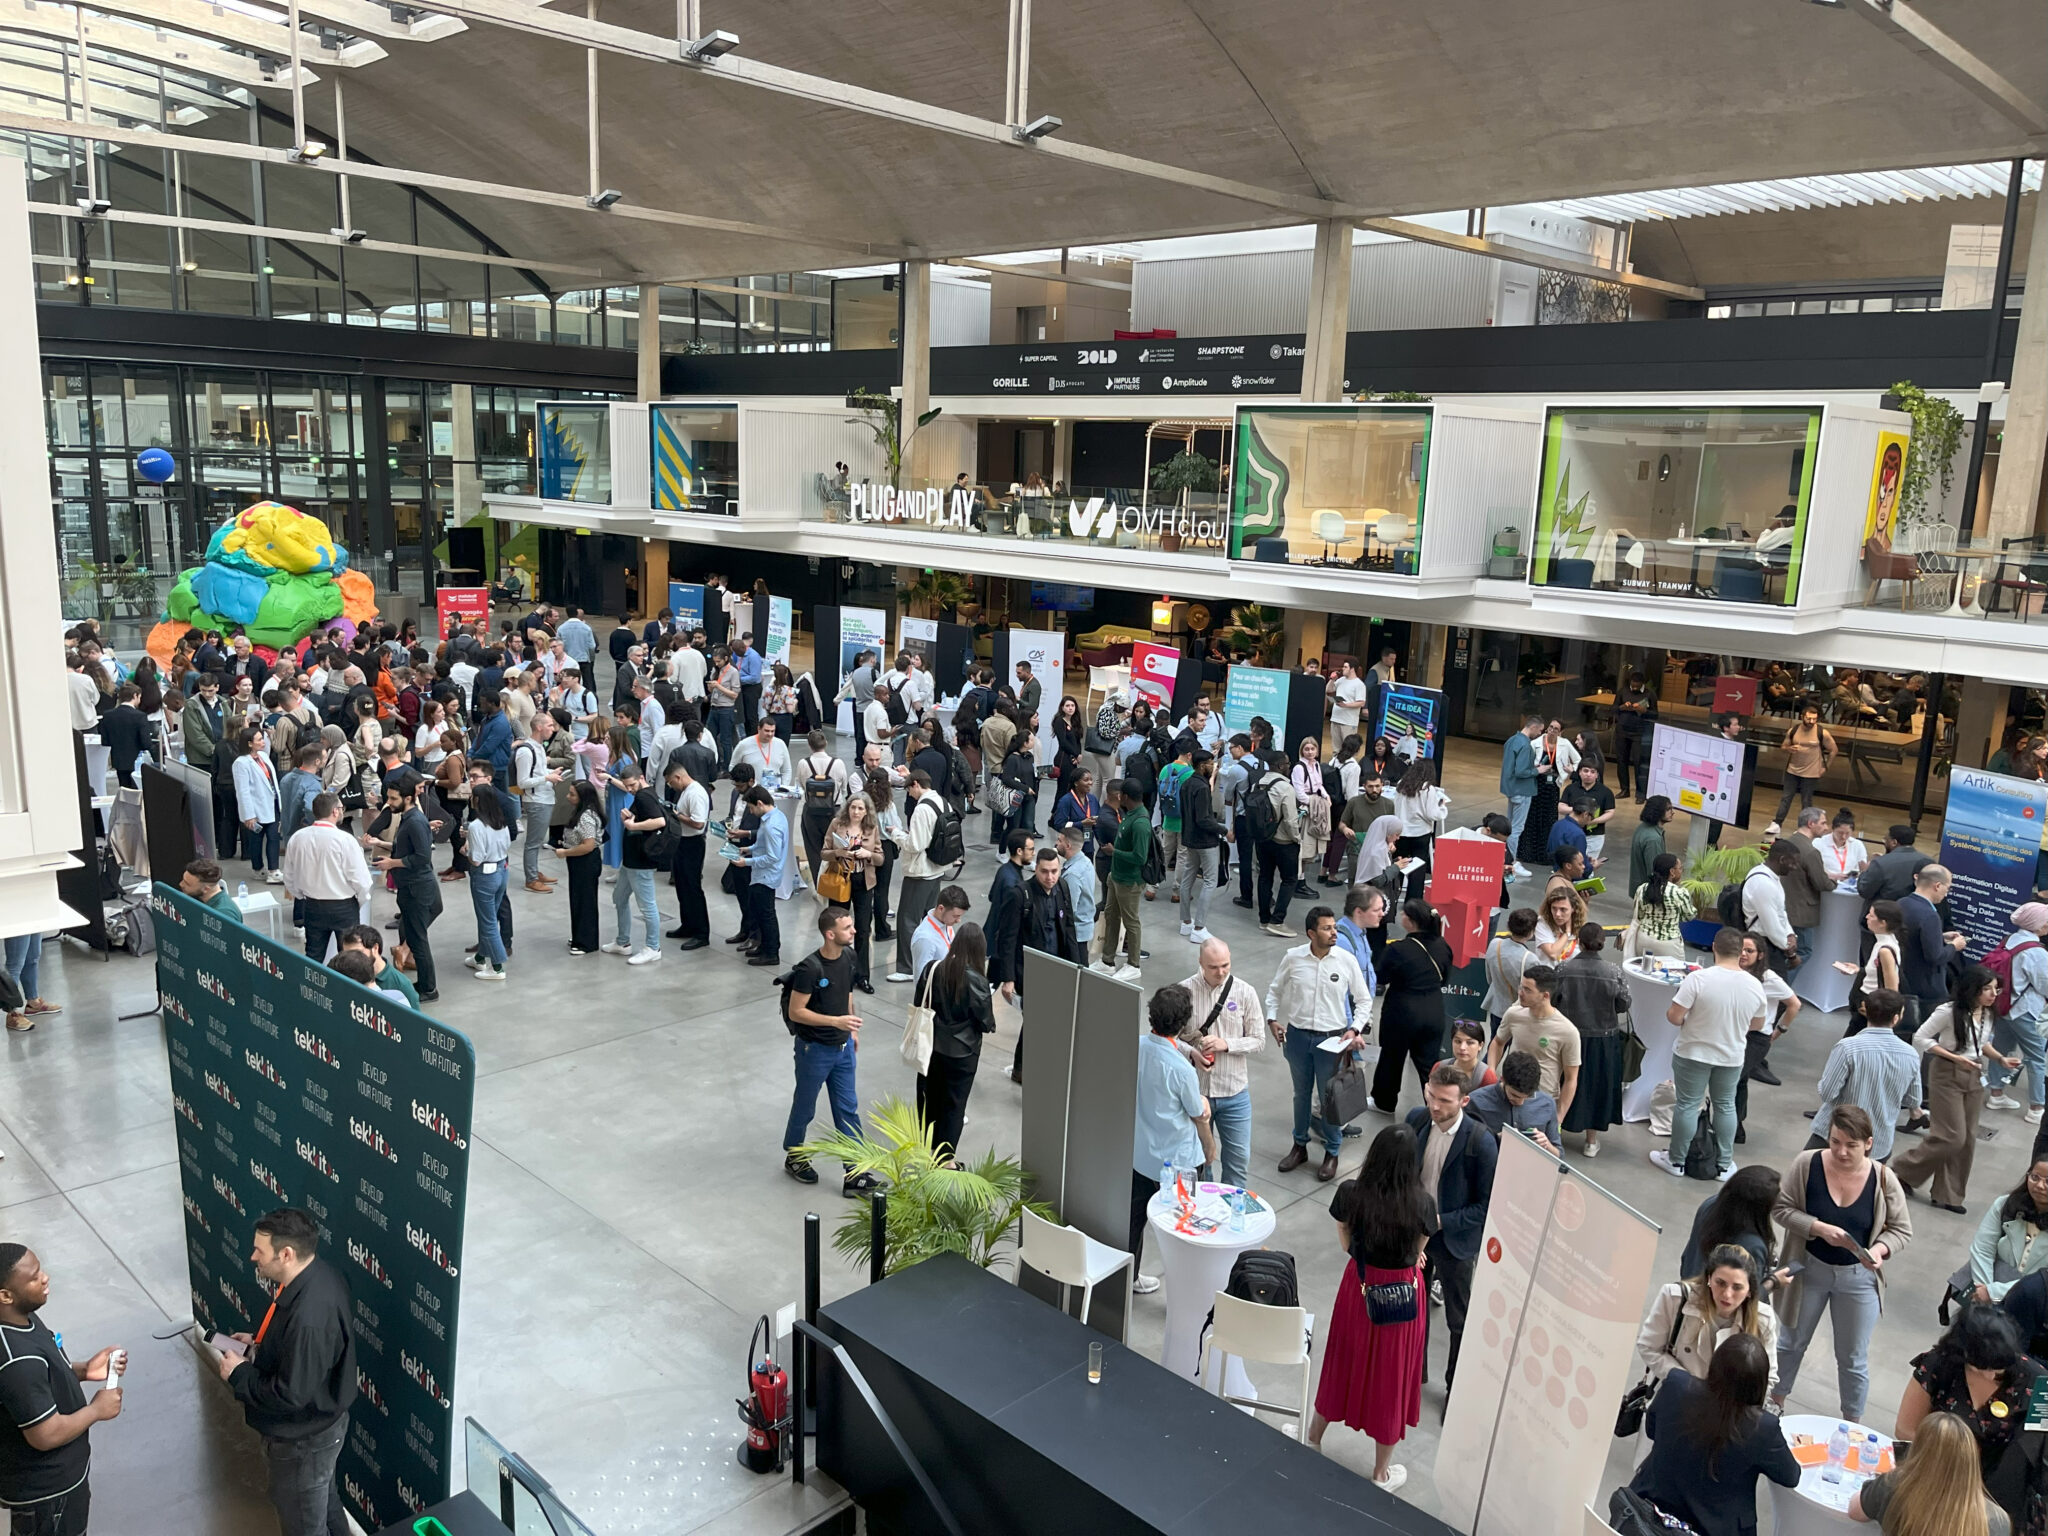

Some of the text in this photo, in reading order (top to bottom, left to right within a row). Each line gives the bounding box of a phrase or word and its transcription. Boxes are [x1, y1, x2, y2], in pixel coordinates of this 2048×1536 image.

[1078, 350, 1117, 364] BOLD
[1197, 346, 1244, 355] SHARPSTONE
[1173, 378, 1208, 388] Amplitude
[841, 565, 855, 580] UP
[1622, 579, 1650, 587] SUBWAY
[1657, 581, 1692, 591] TRAMWAY
[1233, 672, 1243, 681] Pour
[1395, 702, 1422, 714] IT & IDEA
[1963, 774, 2033, 801] Artik Consulting
[1945, 830, 2034, 857] Conseil en architecture des
[1949, 839, 1982, 853] Systèmes
[1447, 873, 1494, 883] TABLE RONDE
[1458, 866, 1485, 875] ESPACE
[1994, 882, 2018, 895] Digitale
[1967, 904, 1978, 914] Big
[1978, 907, 1995, 917] Data
[304, 966, 328, 989] DEVELOP
[300, 984, 333, 1014] YOUR FUTURE
[428, 1027, 456, 1052] DEVELOP
[362, 1061, 388, 1086] DEVELOP
[421, 1047, 462, 1081] YOUR FUTURE
[306, 1078, 329, 1103] DEVELOP
[357, 1078, 393, 1112] YOUR FUTURE
[422, 1151, 449, 1180] DEVELOP
[360, 1177, 384, 1205] DEVELOP
[416, 1169, 453, 1209] YOUR FUTURE
[355, 1194, 389, 1232] YOUR FUTURE
[416, 1282, 440, 1312] DEVELOP
[410, 1299, 445, 1341] YOUR FUTURE
